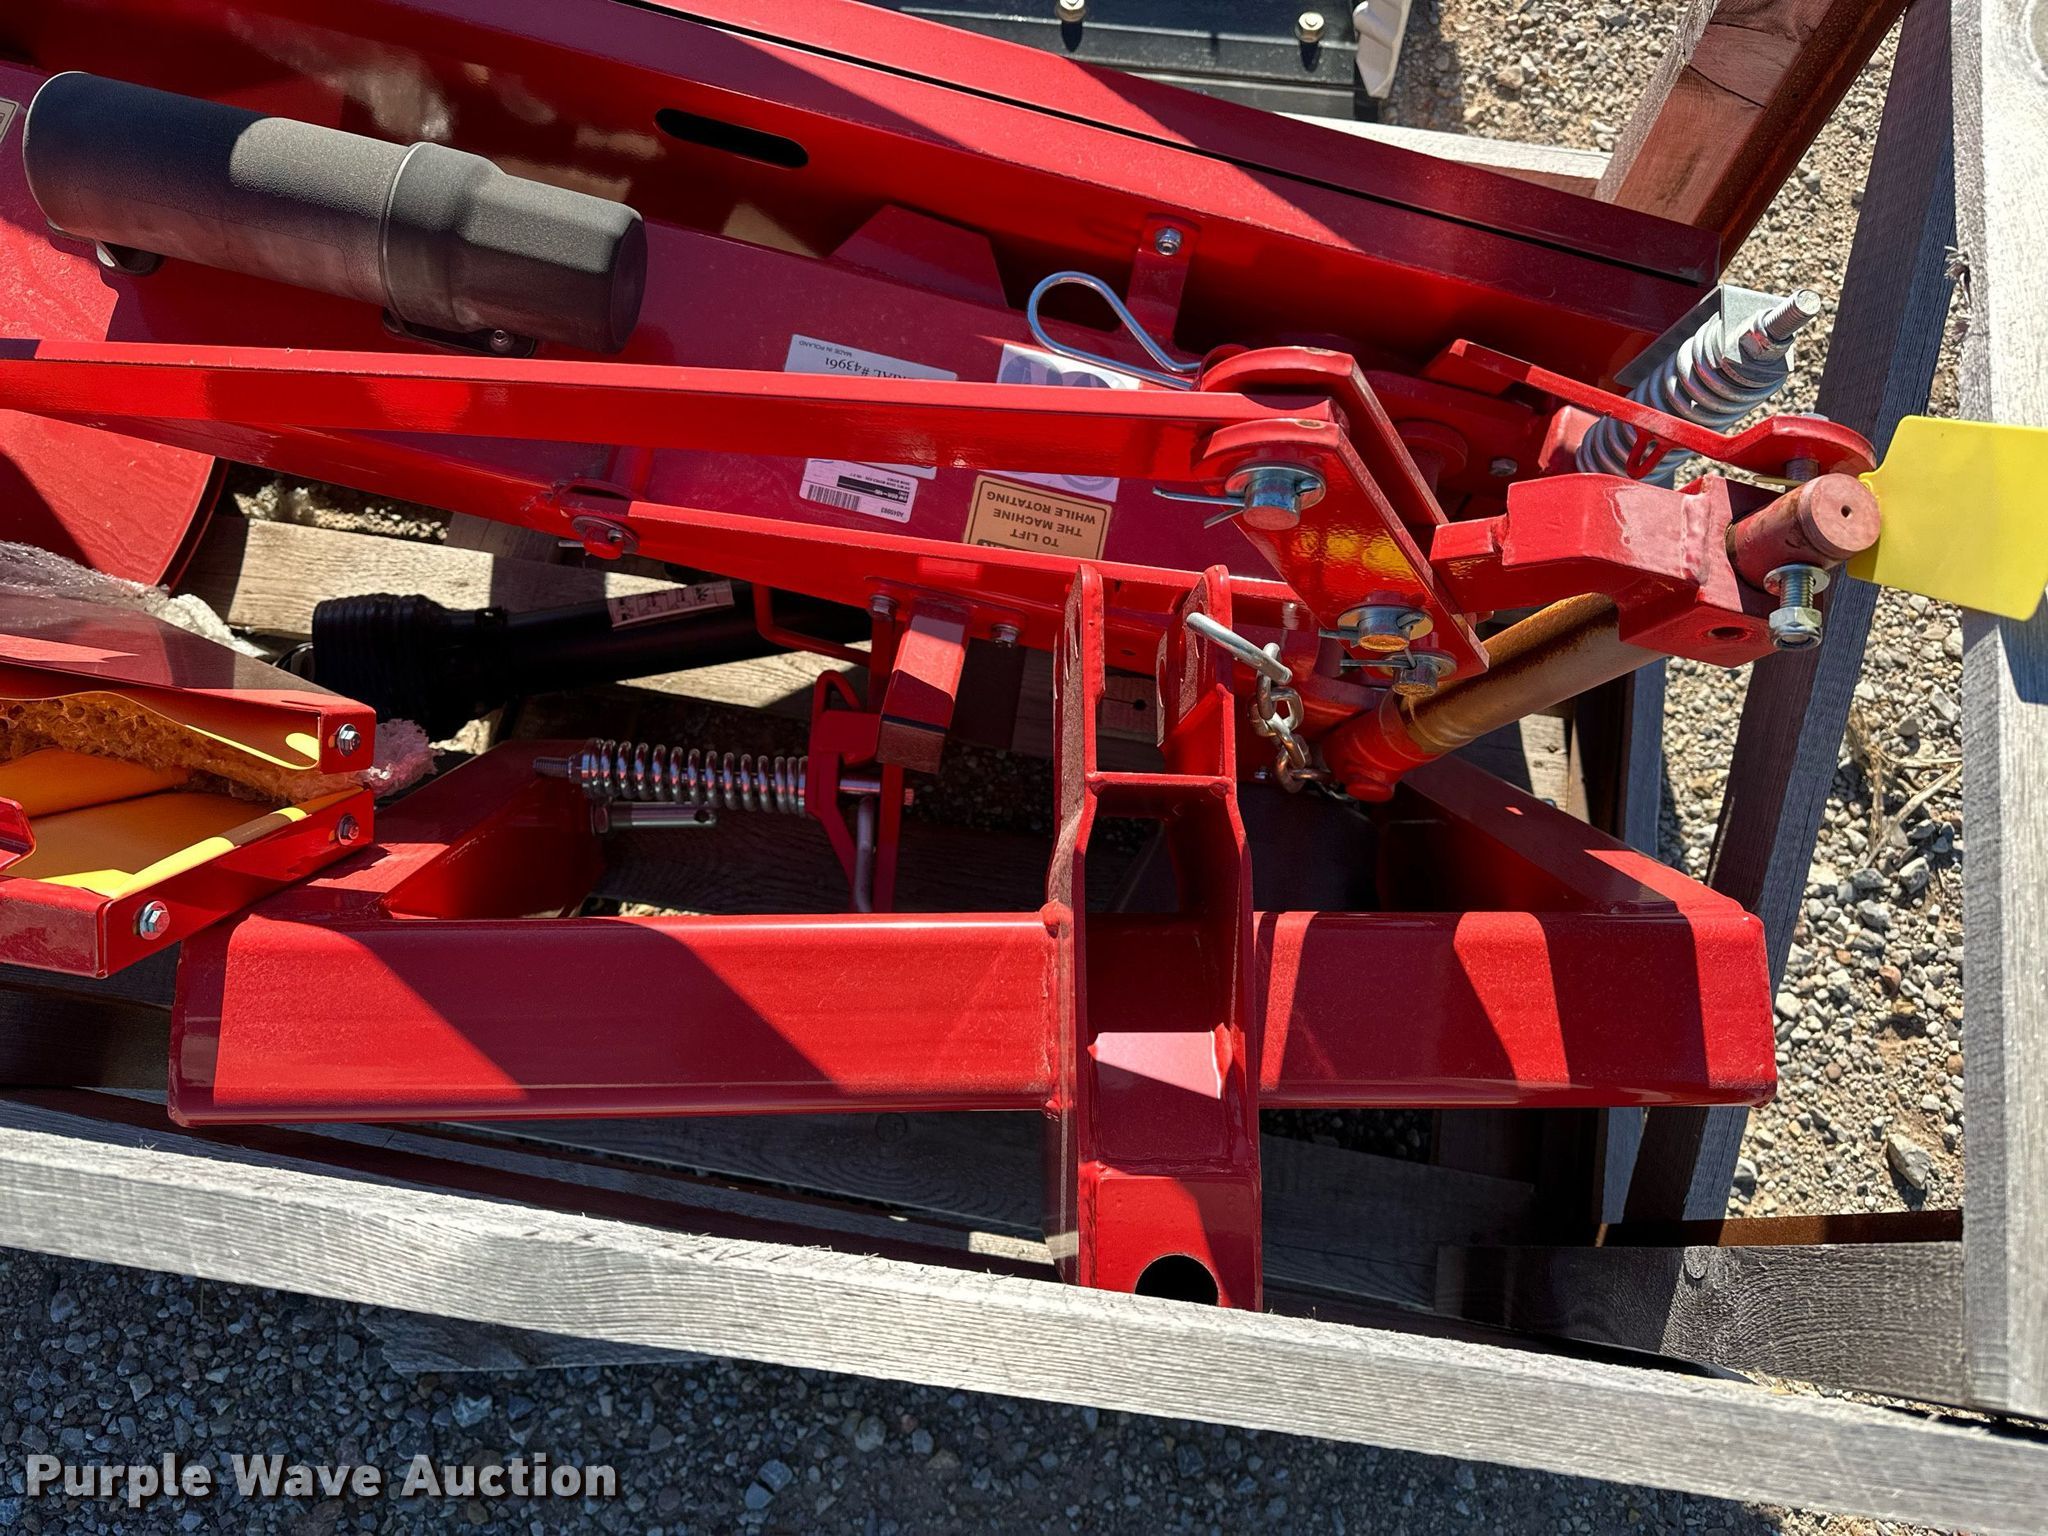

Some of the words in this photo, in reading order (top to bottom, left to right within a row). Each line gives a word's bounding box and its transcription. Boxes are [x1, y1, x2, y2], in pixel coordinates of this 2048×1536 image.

[799, 340, 826, 351] POLAND
[833, 348, 852, 357] MADE
[987, 491, 1051, 513] ROTATING
[993, 508, 1053, 530] MACHINE
[1054, 508, 1095, 525] WHILE
[1010, 528, 1039, 543] LIFT
[1056, 523, 1082, 537] THE
[1042, 536, 1059, 548] TO
